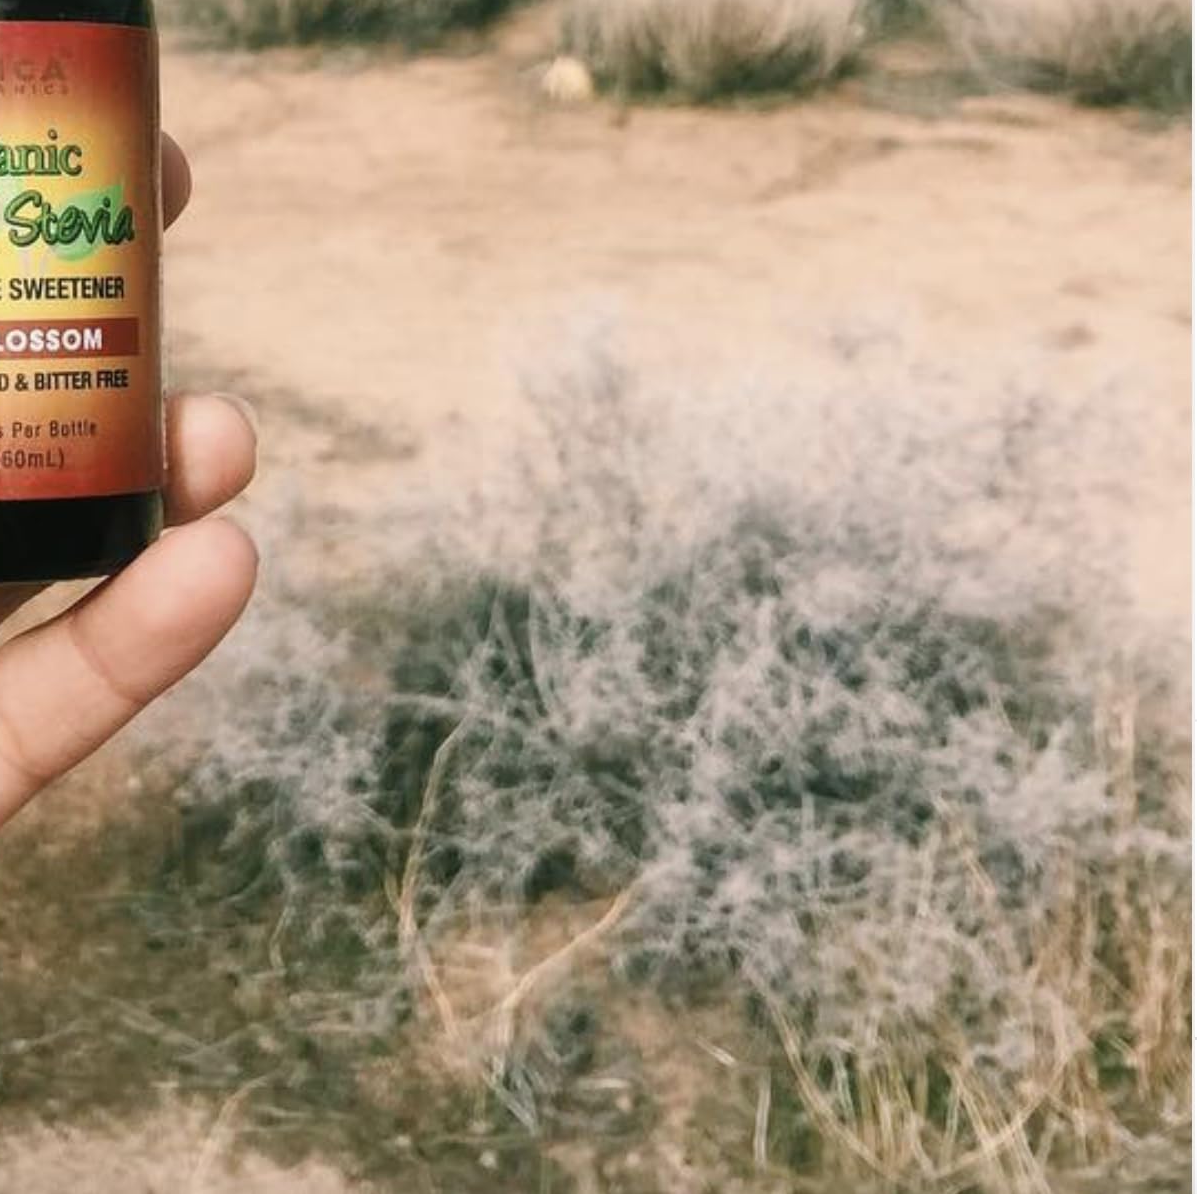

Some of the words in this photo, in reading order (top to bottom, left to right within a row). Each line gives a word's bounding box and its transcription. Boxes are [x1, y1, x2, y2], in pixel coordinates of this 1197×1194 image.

[3, 189, 135, 246] Stevia
[9, 276, 125, 300] SWEETENER
[14, 372, 29, 391] &
[34, 371, 91, 389] BITTER
[96, 368, 129, 388] FREE
[12, 421, 41, 439] Per
[49, 419, 97, 438] Bottle
